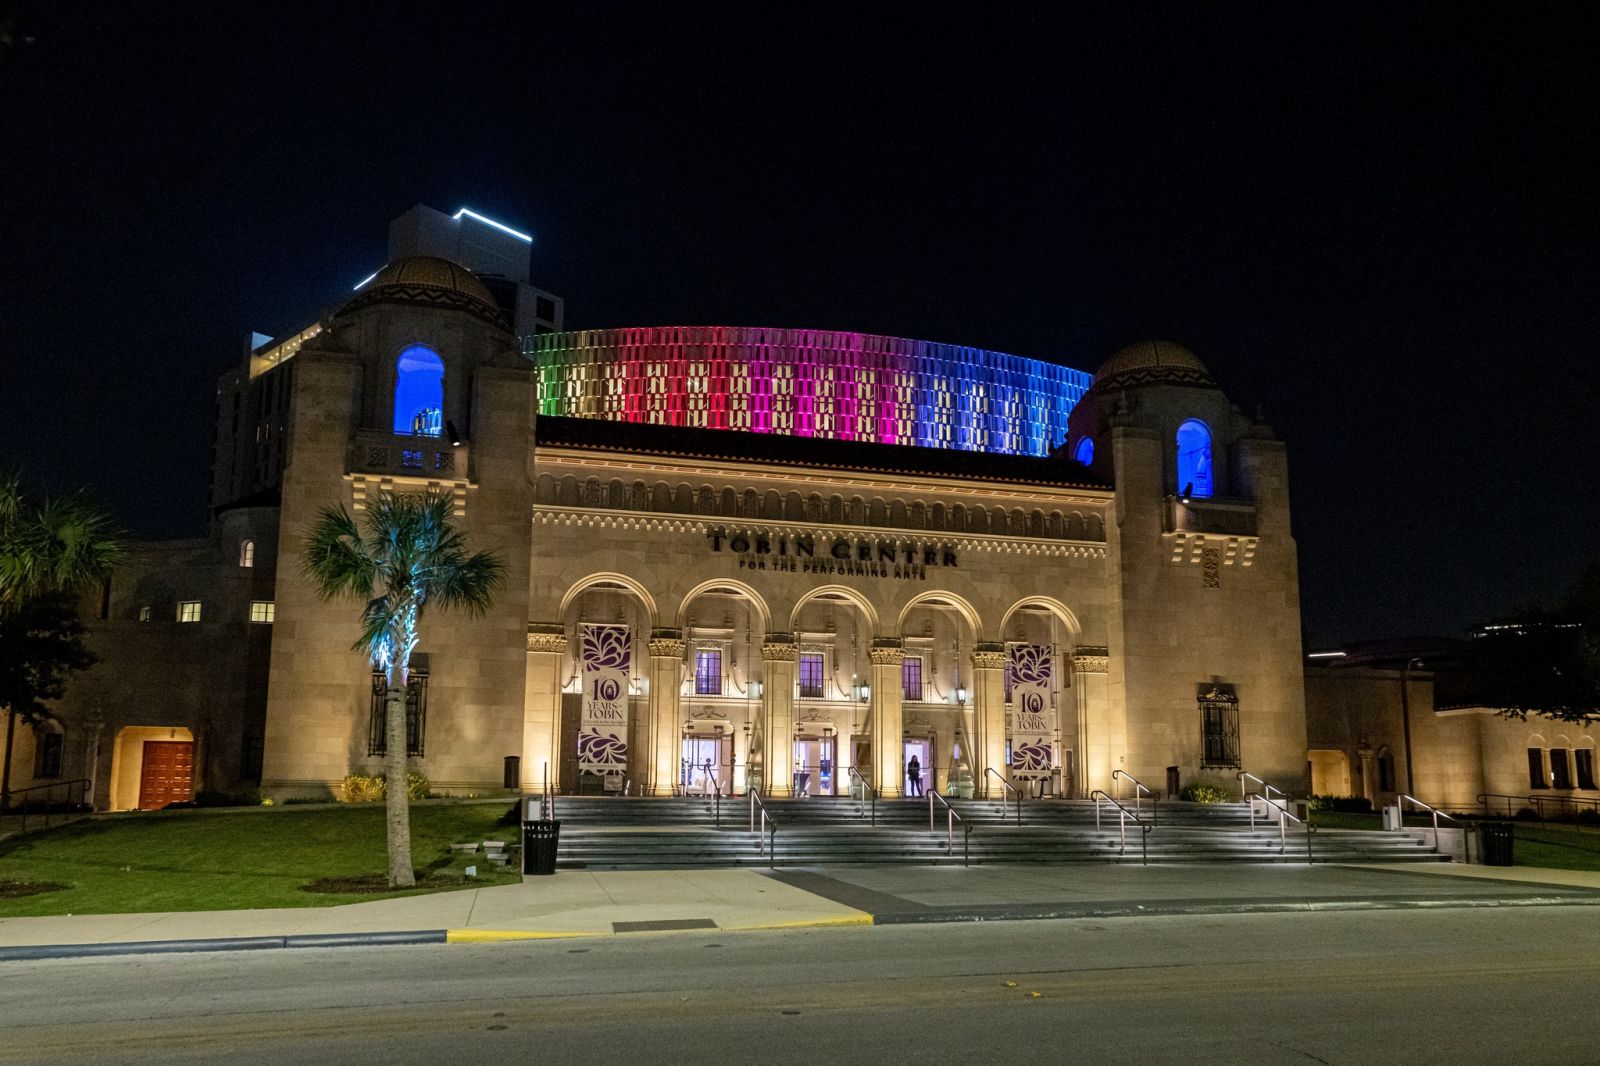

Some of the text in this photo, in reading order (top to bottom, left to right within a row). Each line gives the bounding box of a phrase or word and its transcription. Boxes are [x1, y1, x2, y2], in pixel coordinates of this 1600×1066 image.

[706, 533, 958, 568] TOBIN CENTER
[738, 560, 926, 581] FOR THE PERFORMING ARTS
[593, 679, 620, 701] 10
[1021, 693, 1044, 713] 10
[587, 710, 623, 719] TOBIN
[1016, 713, 1042, 721] YEARS
[1017, 720, 1047, 730] TOBIN
